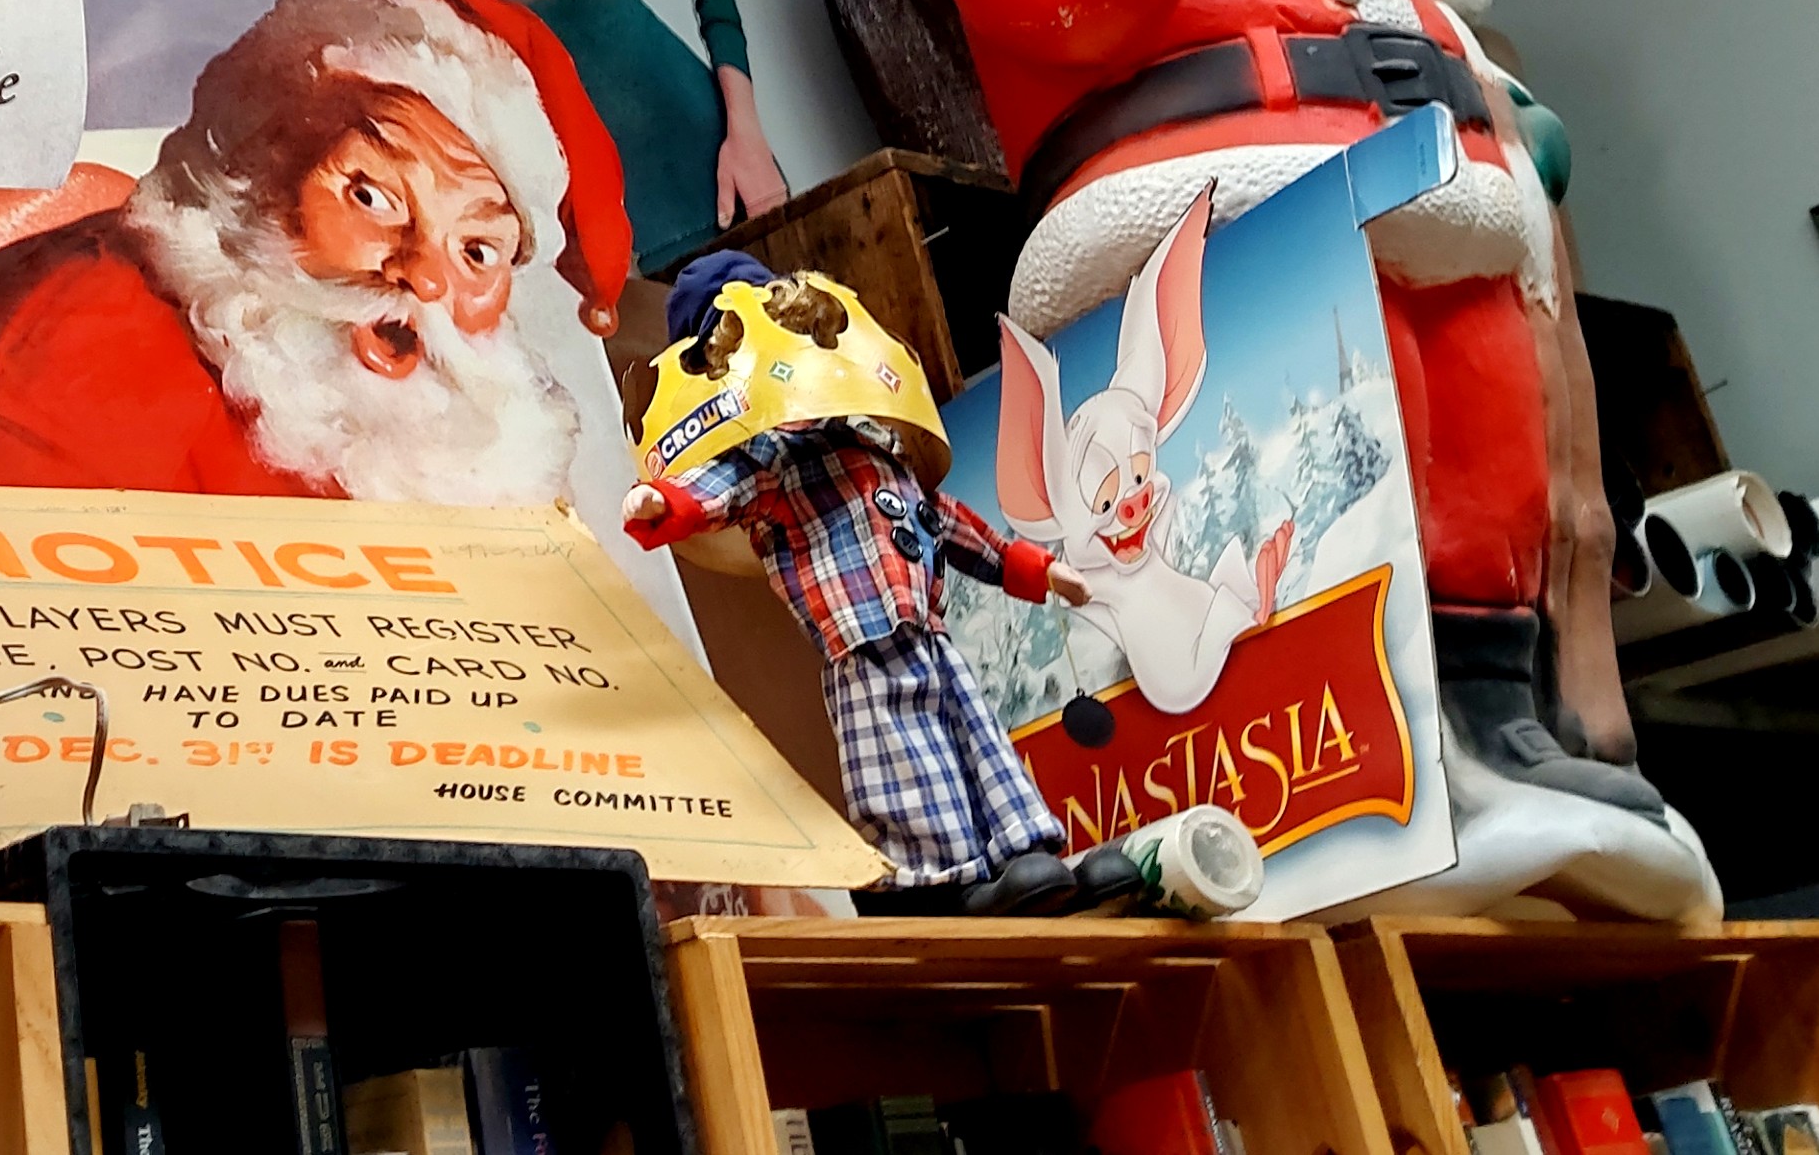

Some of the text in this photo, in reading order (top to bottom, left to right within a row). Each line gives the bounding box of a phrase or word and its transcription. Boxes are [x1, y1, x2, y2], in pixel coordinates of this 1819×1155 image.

[661, 389, 740, 460] CROWN
[213, 611, 342, 637] MUST
[366, 615, 593, 653] REGISTER
[78, 646, 204, 672] POST
[232, 652, 311, 674] NO.
[323, 654, 366, 669] and
[386, 655, 527, 681] CARD
[543, 662, 620, 691] NO.
[142, 683, 240, 704] HAVE
[259, 684, 350, 704] DUES
[370, 686, 451, 706] PAID
[470, 691, 519, 709] UP
[187, 710, 399, 730] TO DATE
[1, 735, 160, 765] DEC.
[308, 739, 359, 766] IS
[387, 740, 646, 779] DEADLINE
[1024, 680, 1359, 857] NASTASIA
[433, 782, 734, 819] HOUSE COMMITTEE
